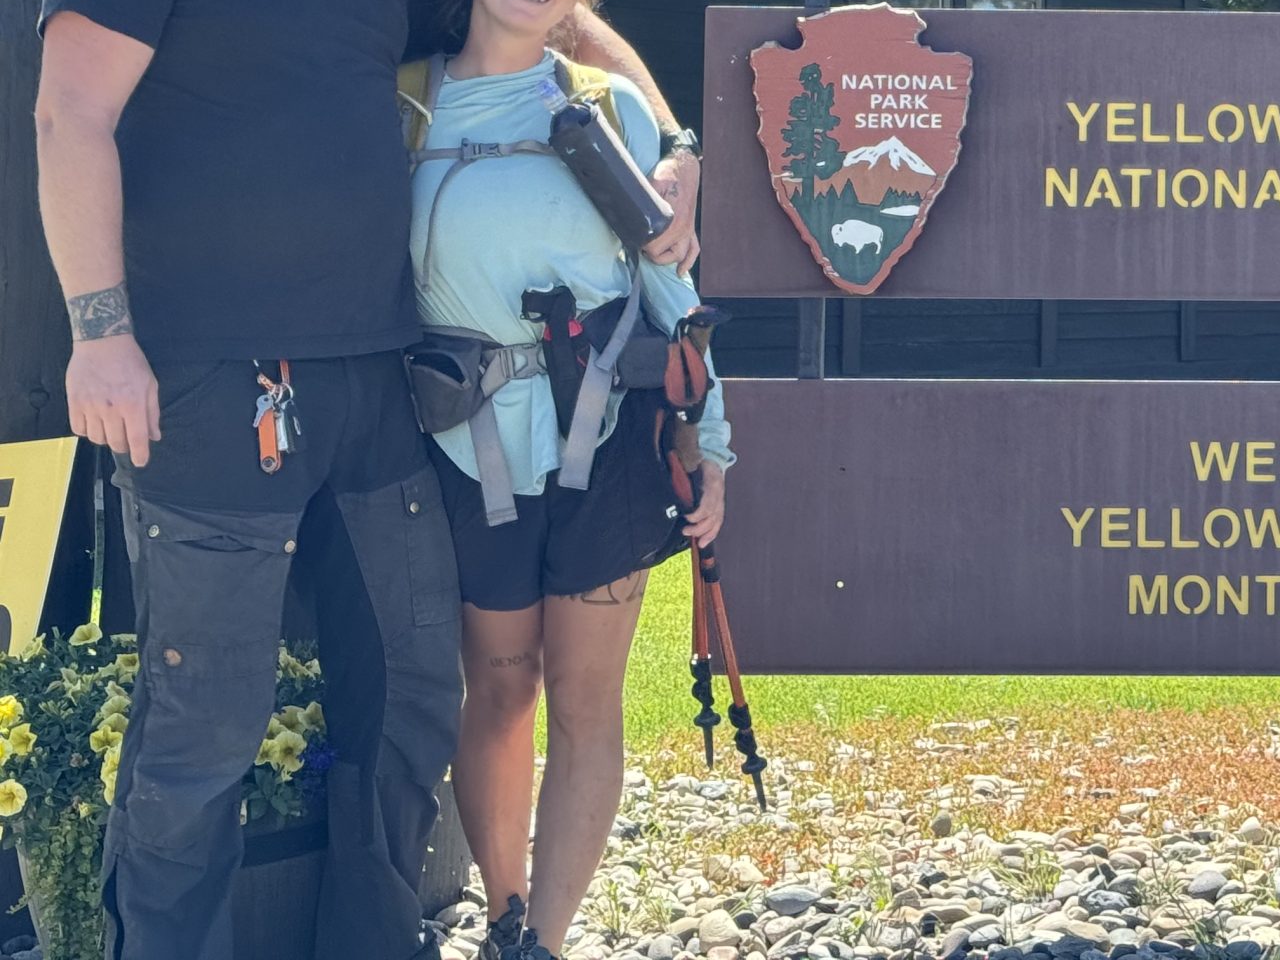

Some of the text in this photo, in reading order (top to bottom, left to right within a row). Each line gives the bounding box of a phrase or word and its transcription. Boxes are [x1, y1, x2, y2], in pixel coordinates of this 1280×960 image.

[842, 73, 957, 91] NATIONAL
[870, 93, 929, 110] PARK
[855, 112, 943, 129] SERVICE
